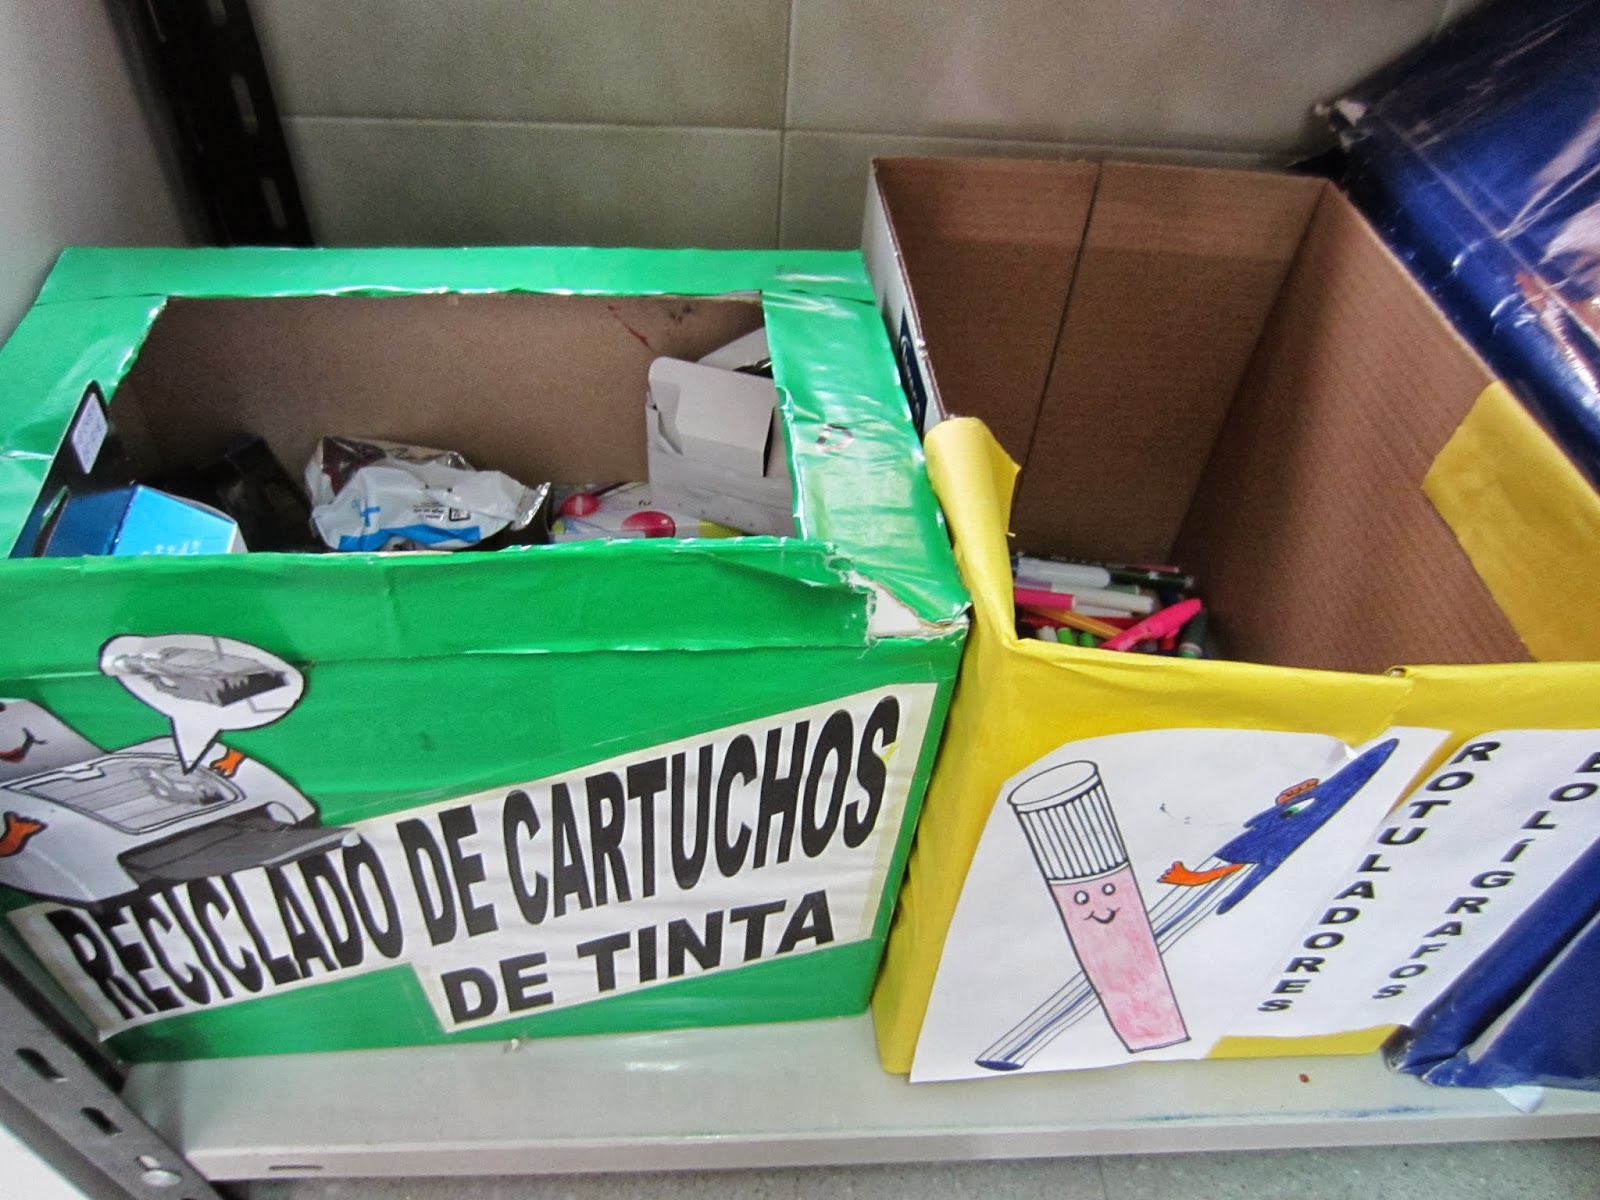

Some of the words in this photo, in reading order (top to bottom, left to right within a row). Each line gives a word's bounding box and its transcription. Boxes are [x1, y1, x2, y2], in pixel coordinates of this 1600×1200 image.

[45, 830, 403, 1019] RECICLADO
[397, 805, 498, 946] DE
[503, 695, 900, 925] CARTUCHOS
[440, 951, 554, 1025] DE
[576, 889, 834, 993] TINTA
[1256, 741, 1501, 1013] ROTULADORES
